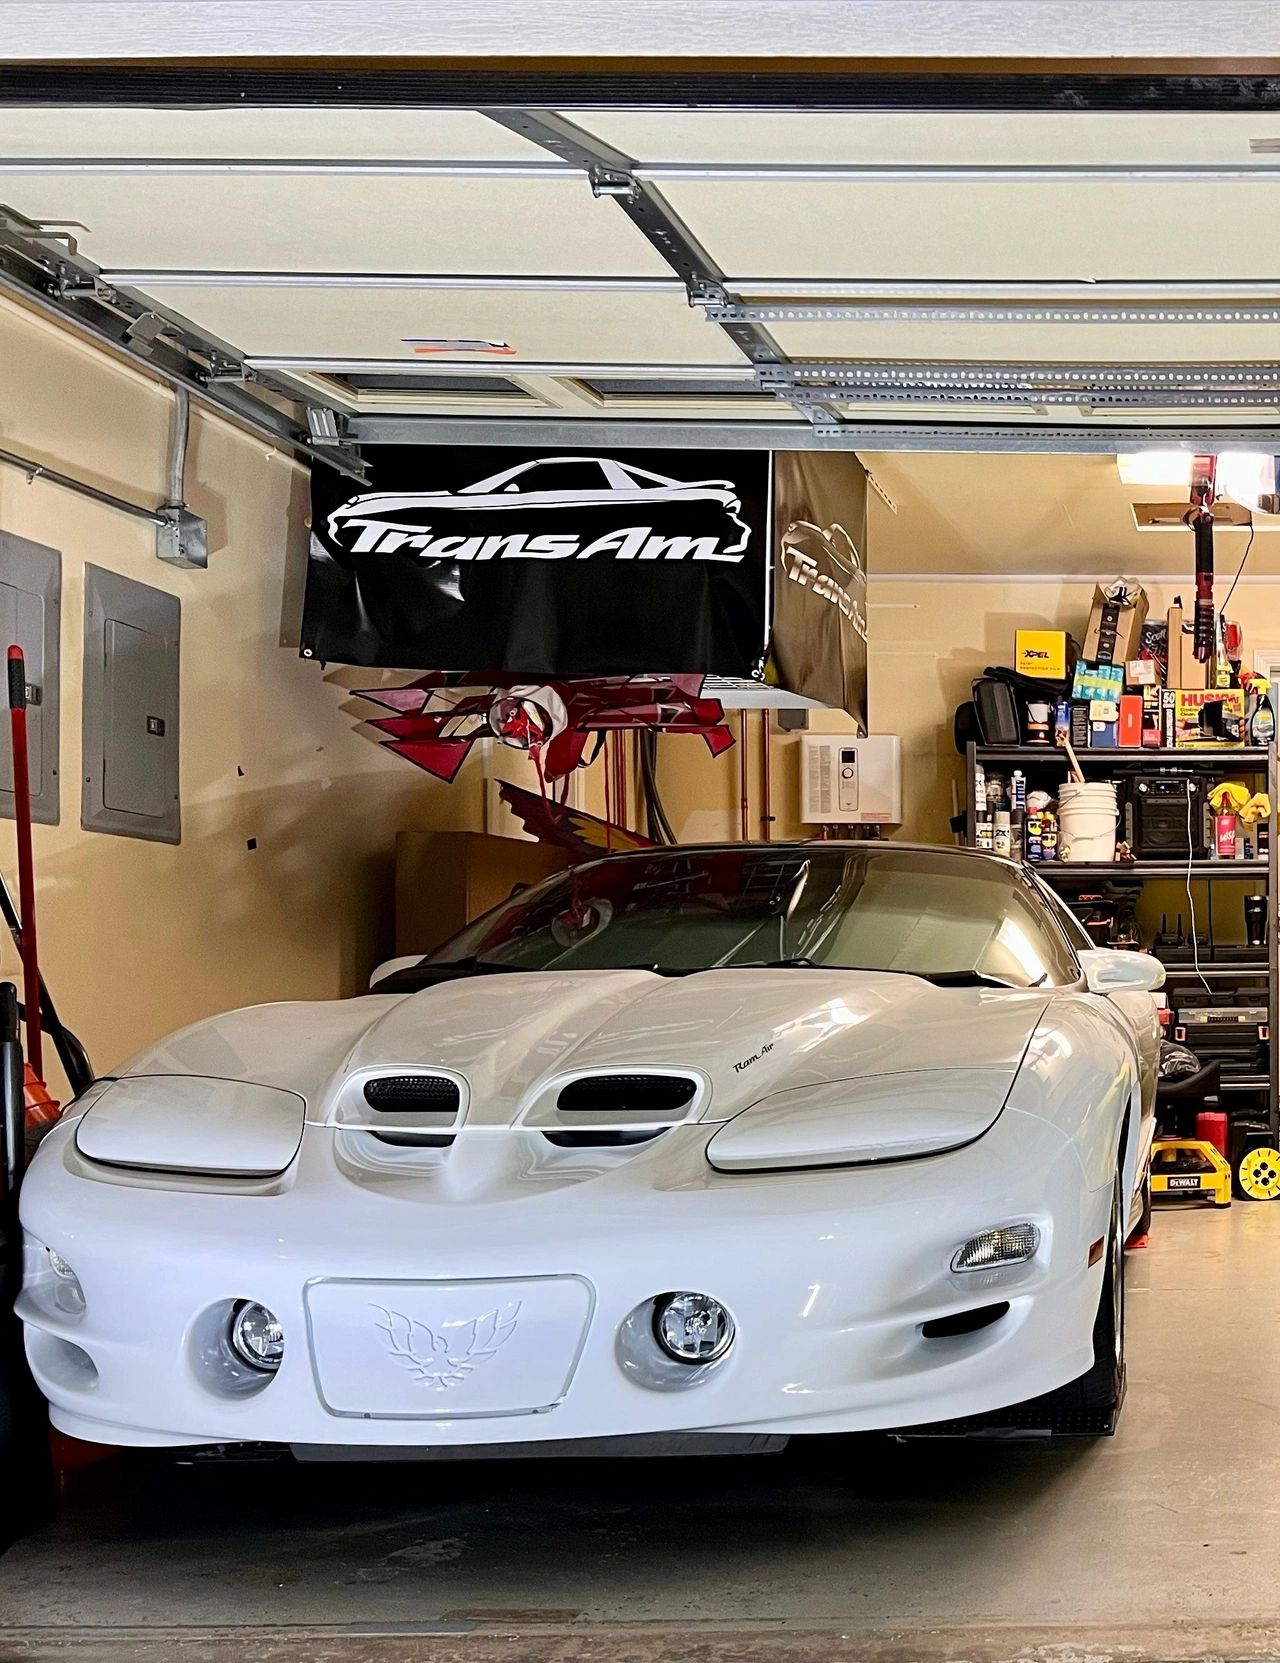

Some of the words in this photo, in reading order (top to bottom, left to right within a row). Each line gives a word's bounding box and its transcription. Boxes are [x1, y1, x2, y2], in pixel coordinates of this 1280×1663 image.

[342, 519, 580, 560] Trans
[576, 527, 744, 563] Am
[786, 546, 851, 616] Trans
[1146, 629, 1167, 644] Scott
[1024, 650, 1049, 658] XPEL
[1163, 691, 1175, 704] 50
[732, 1054, 761, 1073] Ram
[760, 1043, 774, 1056] Air
